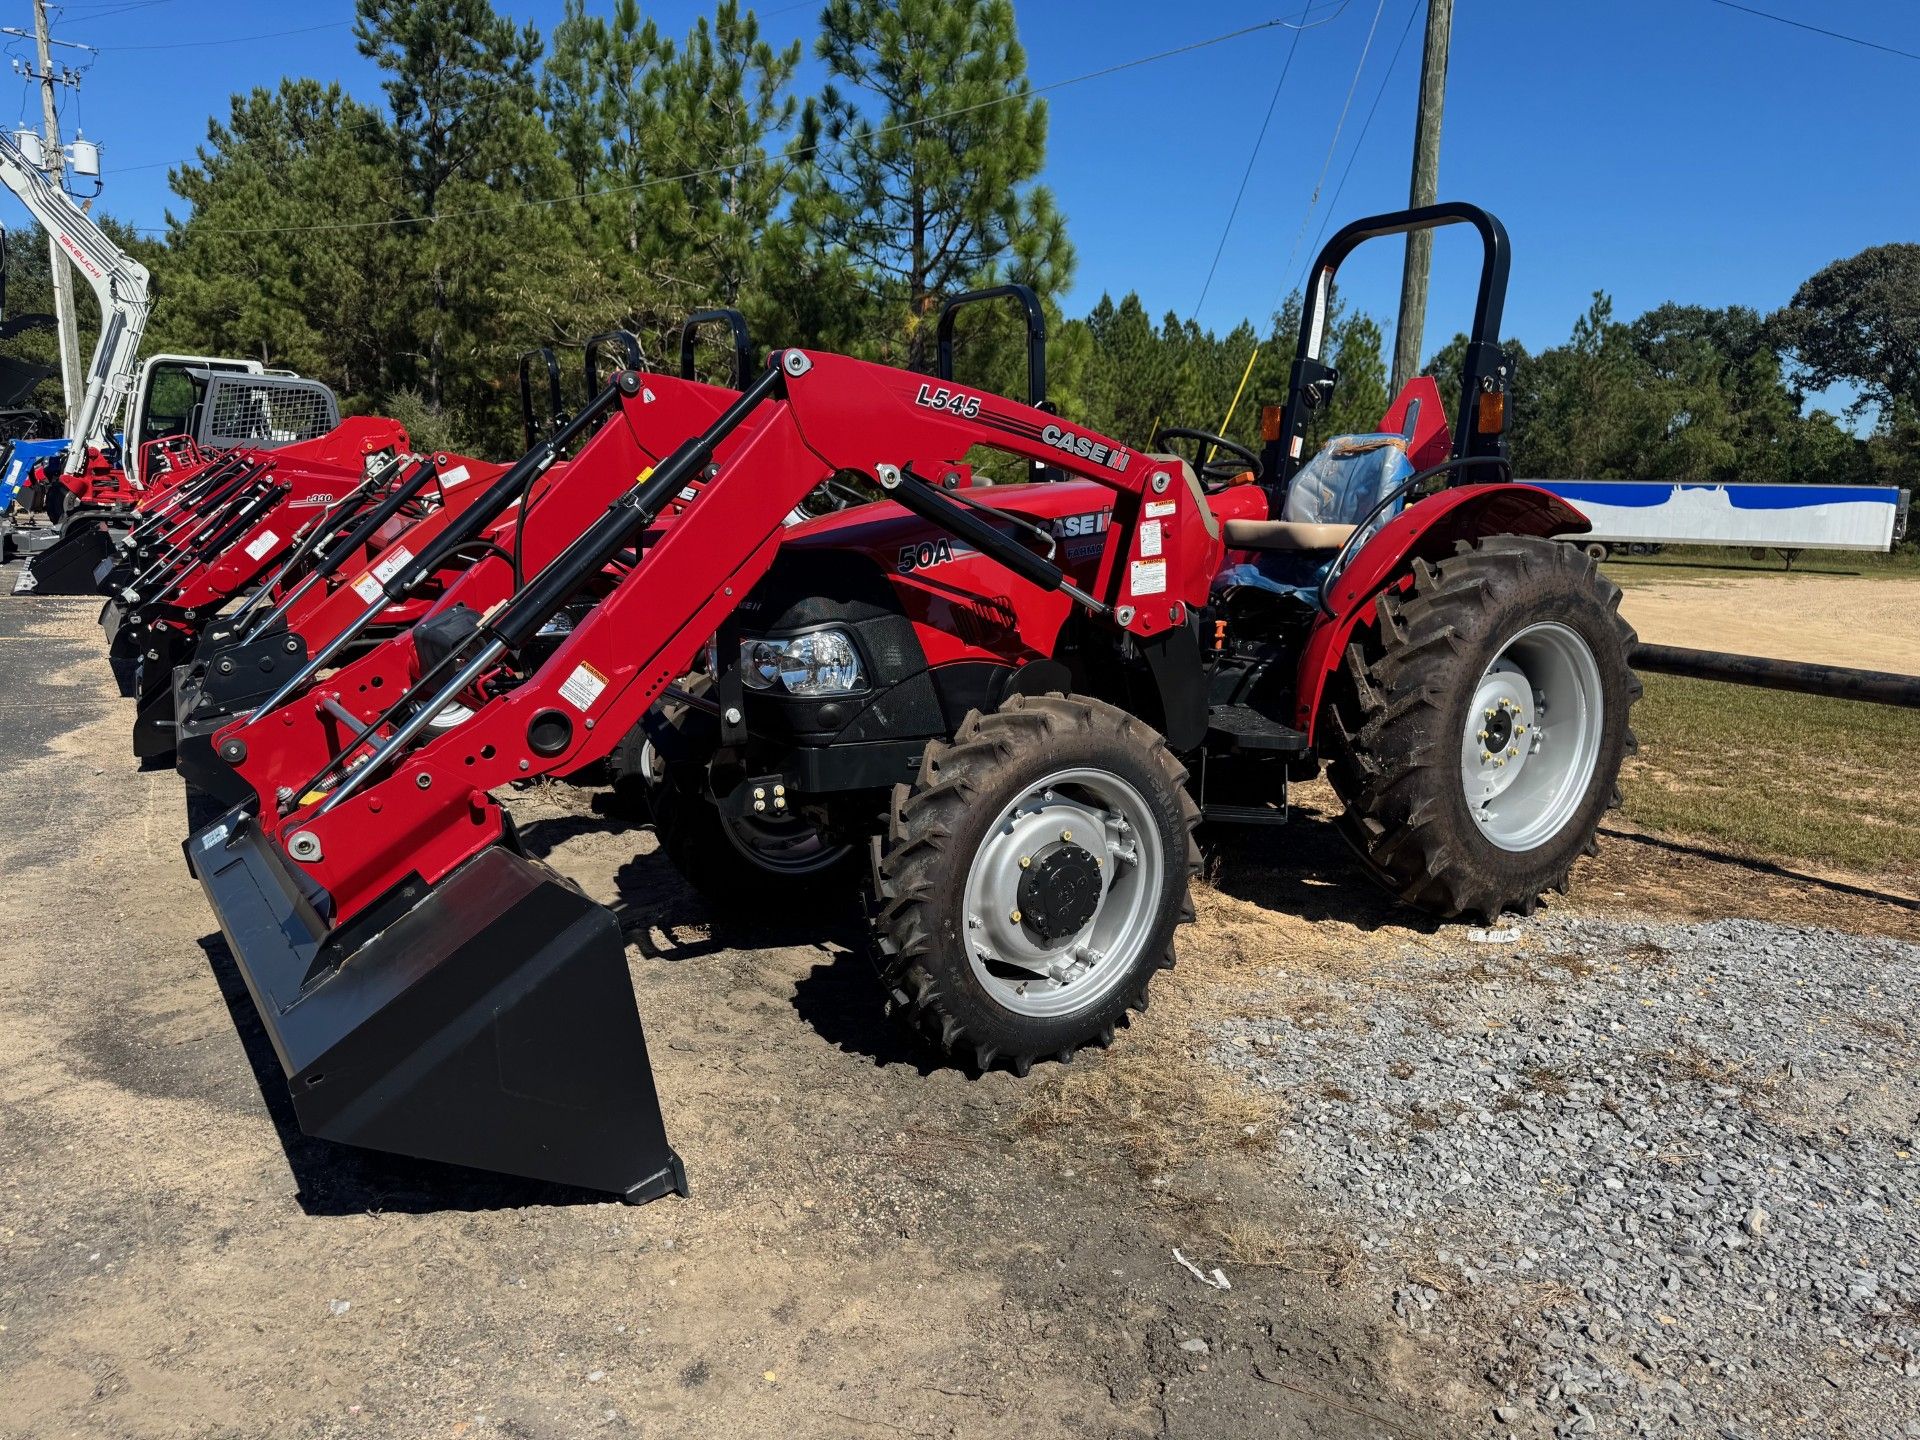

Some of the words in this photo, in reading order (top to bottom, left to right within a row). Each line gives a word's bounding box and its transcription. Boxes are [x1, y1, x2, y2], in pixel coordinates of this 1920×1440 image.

[916, 384, 981, 419] L545
[1041, 425, 1108, 464] CASE
[1034, 514, 1095, 542] CASE
[897, 538, 954, 574] 50A
